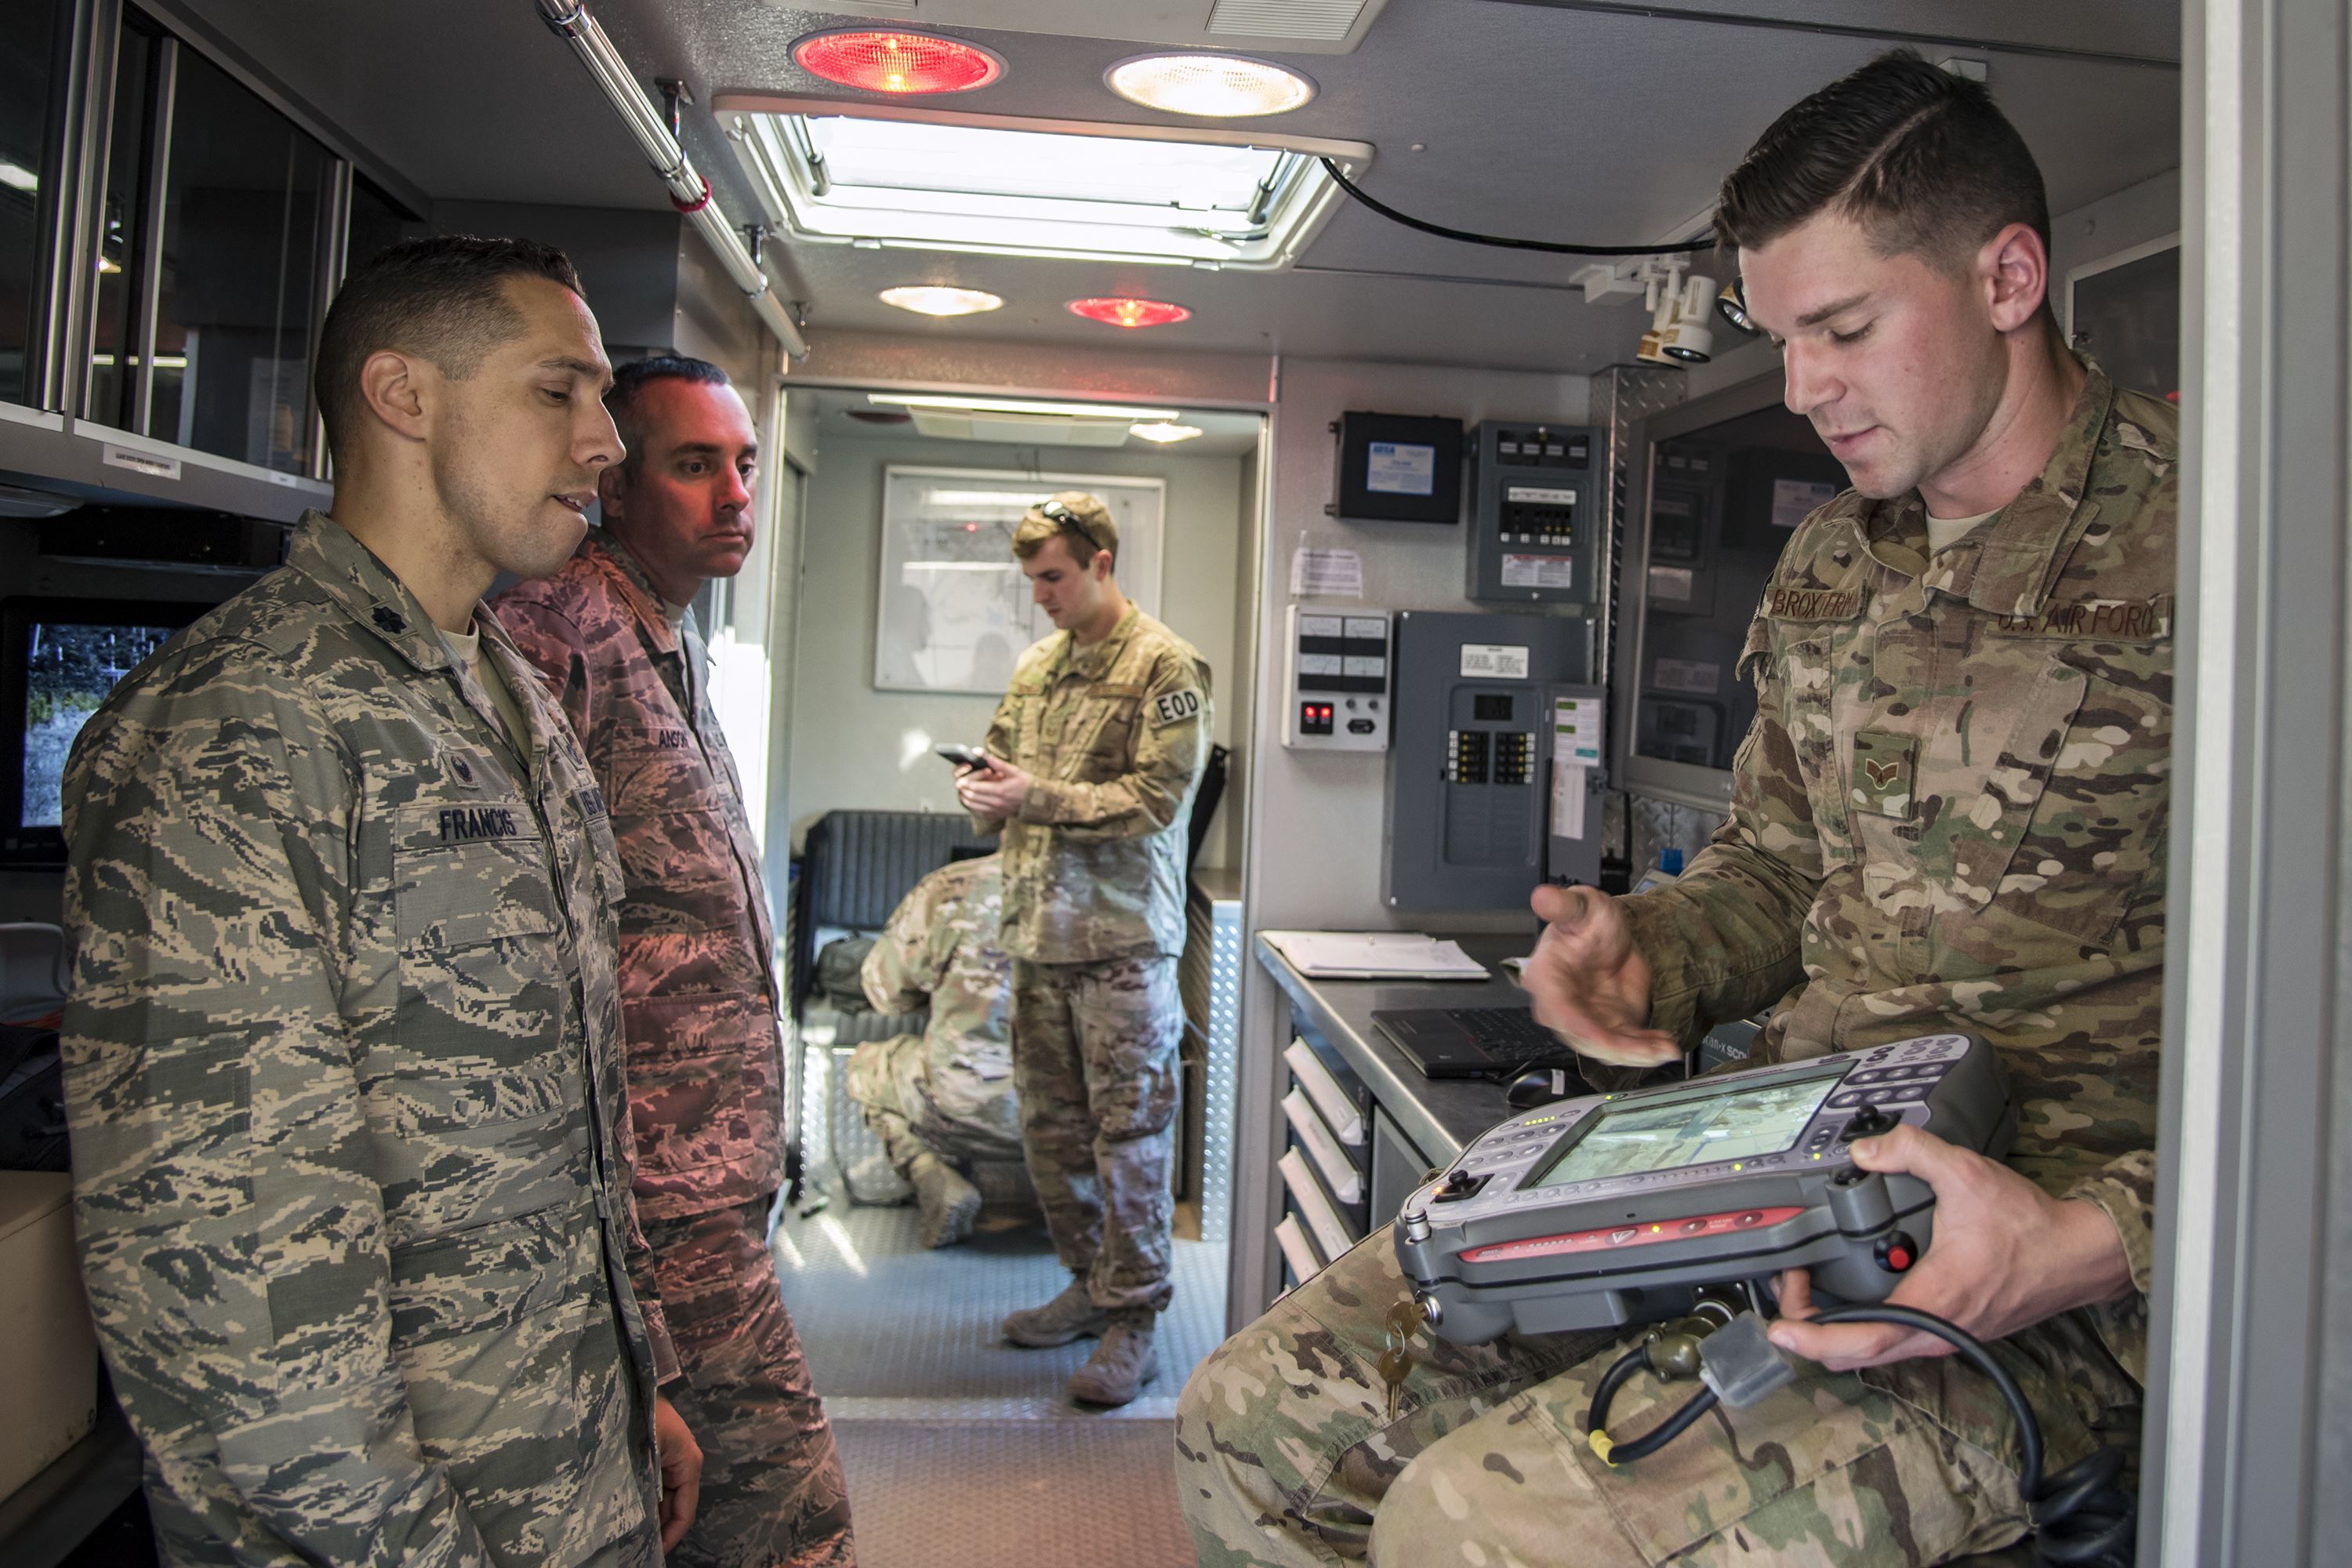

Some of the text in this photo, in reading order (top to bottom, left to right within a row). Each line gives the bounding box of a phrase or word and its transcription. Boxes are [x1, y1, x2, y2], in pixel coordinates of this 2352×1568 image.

[2042, 602, 2085, 634] AIR
[1157, 691, 1198, 720] EOD
[439, 808, 517, 841] FRANCIS
